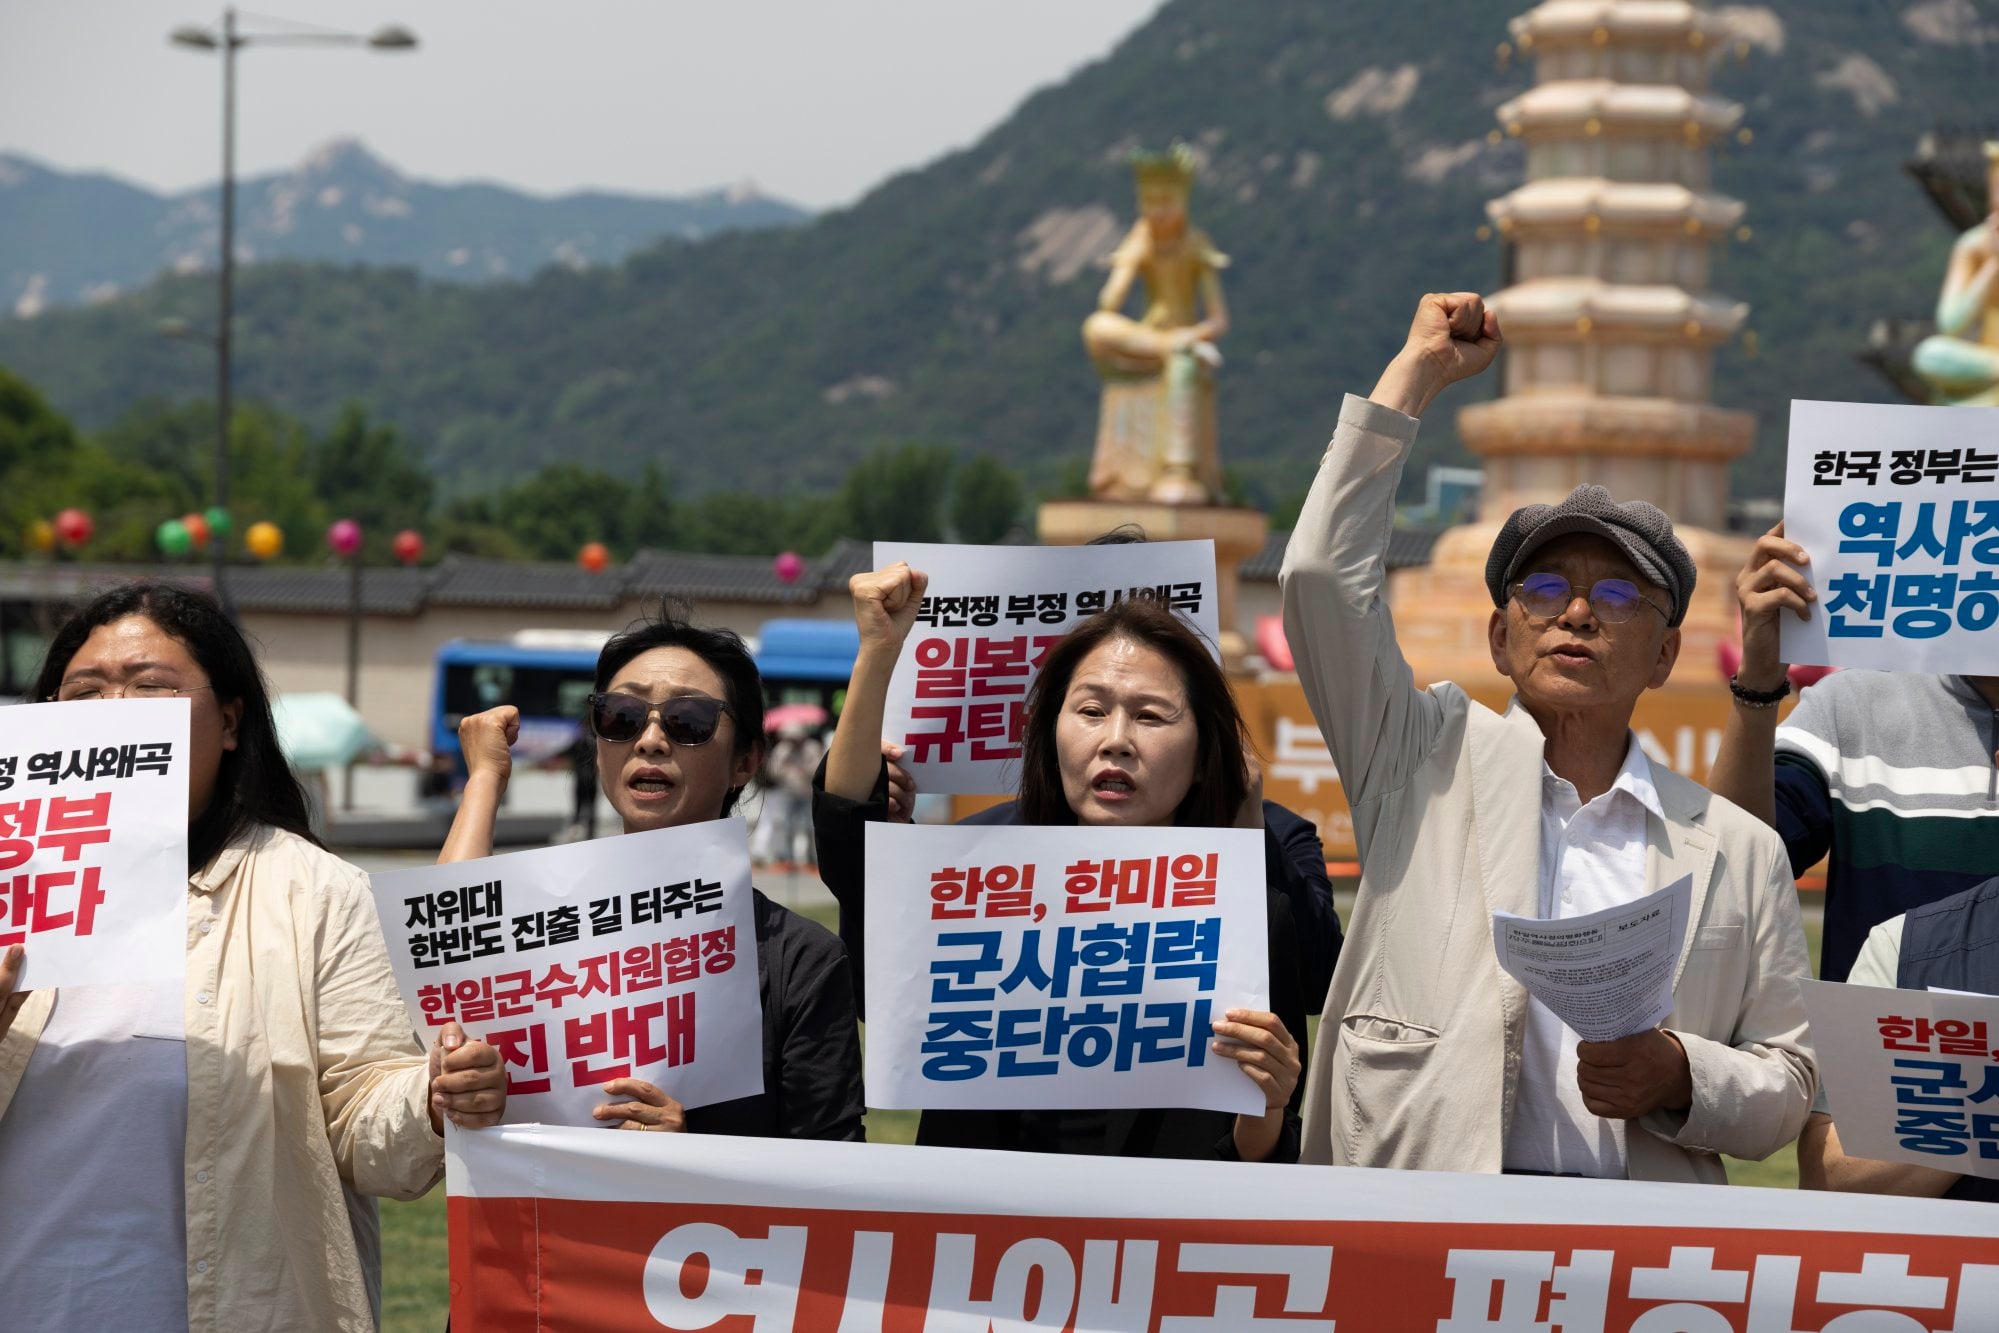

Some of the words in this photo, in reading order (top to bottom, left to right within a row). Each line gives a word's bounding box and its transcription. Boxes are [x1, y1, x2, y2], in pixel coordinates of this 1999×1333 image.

[1812, 450, 1882, 486] 한국
[1888, 448, 1999, 486] 정부는
[1005, 592, 1068, 625] 부정
[26, 742, 173, 786] 역사왜곡
[403, 879, 504, 930] 자위대
[407, 921, 506, 970] 한반도
[510, 905, 581, 953] 진출
[588, 895, 624, 937] 길
[630, 878, 724, 925] 터주는
[929, 862, 1048, 924] 한일,
[1064, 852, 1220, 914] 한미일
[416, 925, 737, 1027] 한일군수지원협정
[928, 917, 1222, 1004] 군사협력
[475, 1023, 552, 1096] 진
[563, 991, 697, 1088] 반대
[920, 998, 1216, 1083] 중단하라
